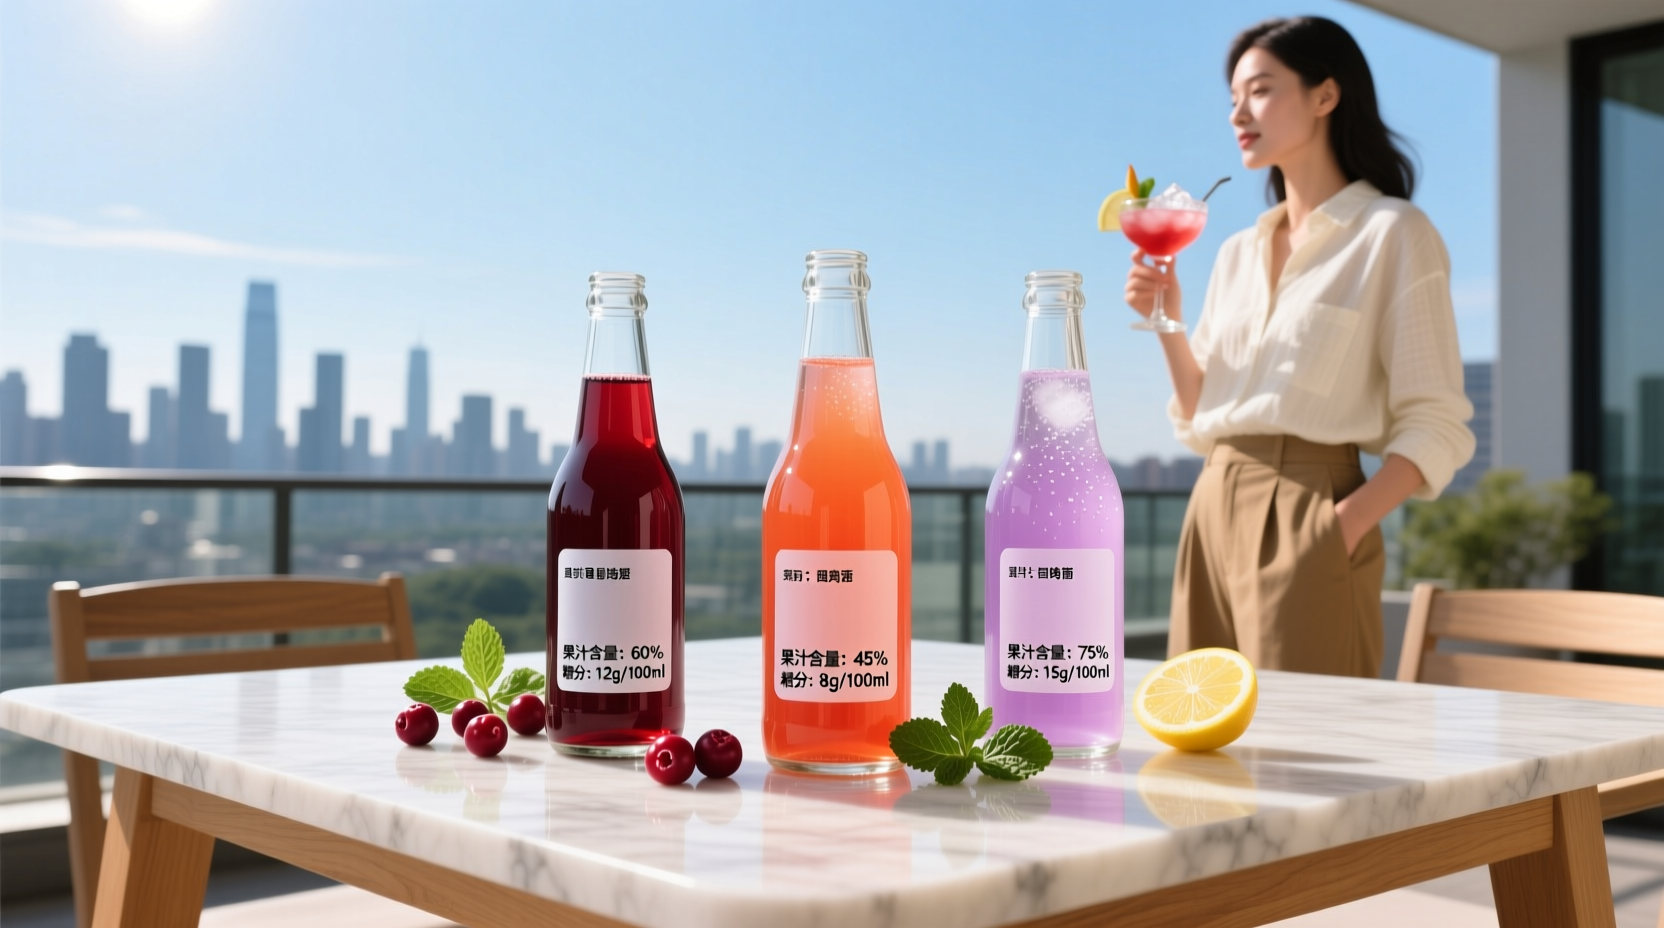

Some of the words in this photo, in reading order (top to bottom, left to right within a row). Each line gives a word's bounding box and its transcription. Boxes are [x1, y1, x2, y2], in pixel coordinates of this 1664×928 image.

[631, 645, 664, 660] 60%
[853, 650, 889, 667] 45%
[1078, 645, 1109, 660] 75%
[596, 664, 665, 684] 12g/100ml
[819, 671, 889, 693] 8g/100ml
